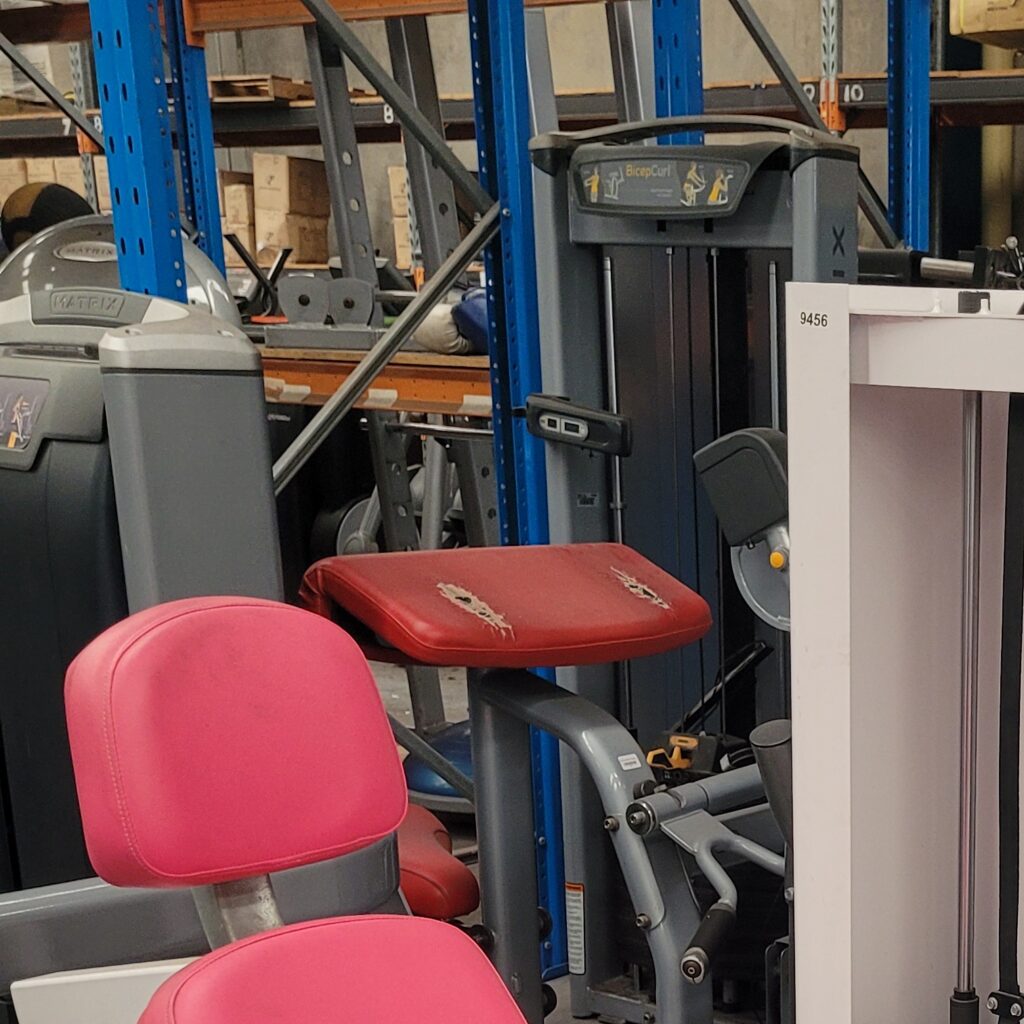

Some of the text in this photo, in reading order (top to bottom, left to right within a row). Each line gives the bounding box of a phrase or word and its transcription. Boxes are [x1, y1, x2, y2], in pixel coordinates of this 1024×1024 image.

[844, 84, 864, 102] 10
[384, 103, 394, 124] 8
[62, 118, 72, 136] 7
[625, 164, 671, 179] BicepCurl
[54, 295, 118, 311] MATRIX
[800, 311, 828, 327] 9456
